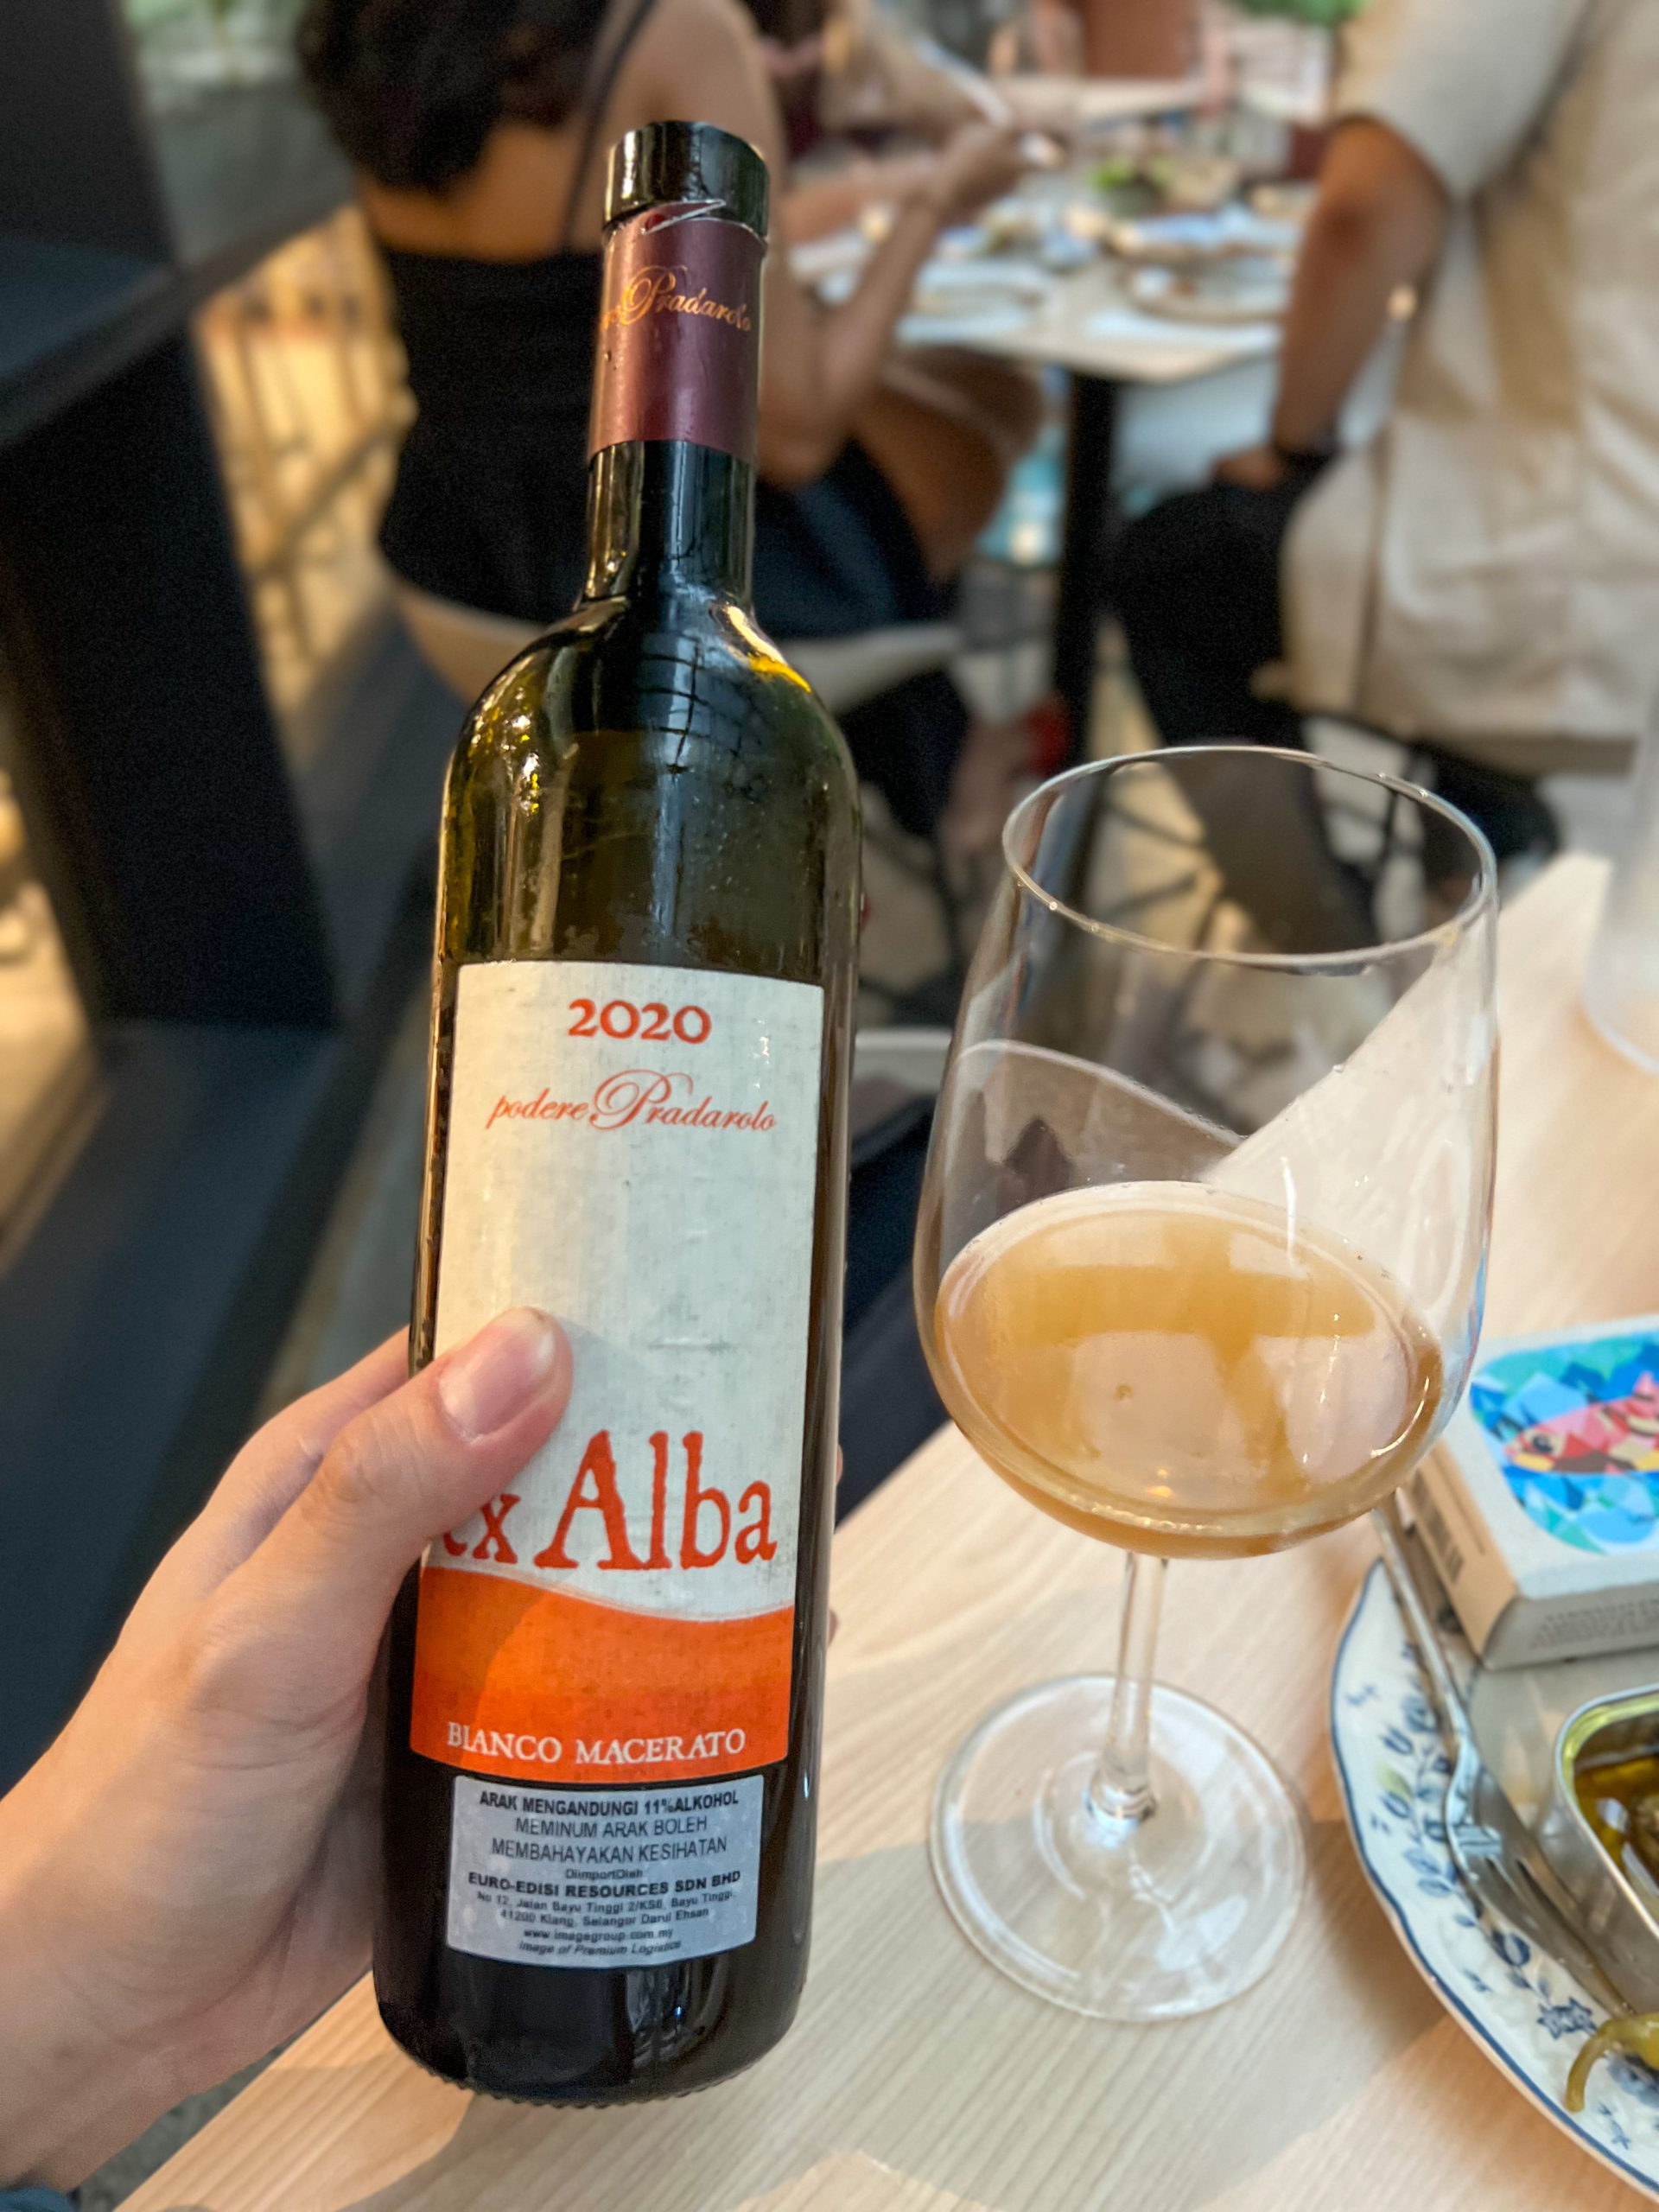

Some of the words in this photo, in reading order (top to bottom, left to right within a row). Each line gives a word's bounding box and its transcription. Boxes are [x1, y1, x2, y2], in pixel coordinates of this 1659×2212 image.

[568, 998, 712, 1044] 2020
[485, 1088, 590, 1129] podere
[589, 1069, 777, 1131] Pradarolo
[533, 1429, 778, 1570] Alba
[575, 1728, 746, 1765] MACERATO
[479, 1790, 518, 1811] ARAK
[522, 1796, 639, 1817] MENGANDUNGI
[516, 1817, 598, 1838] MEMINUM
[602, 1821, 648, 1838] ARAK
[653, 1815, 708, 1836] BOLEH
[492, 1838, 633, 1864] MEMBAHAYAKAN
[639, 1836, 728, 1861] KESIHATAN
[467, 1872, 559, 1897] EURO-EDISI
[565, 1882, 669, 1898] RESOURCES
[675, 1878, 707, 1892] SDN
[711, 1871, 741, 1887] BHD
[517, 1898, 548, 1910] Jalan
[552, 1901, 582, 1912] Bayu
[586, 1902, 624, 1915] Tinggi
[671, 1897, 698, 1908] Bayu
[582, 1916, 636, 1928] Selangor
[641, 1912, 671, 1924] Darul
[676, 1908, 709, 1921] Ehsan
[557, 1944, 572, 1955] of
